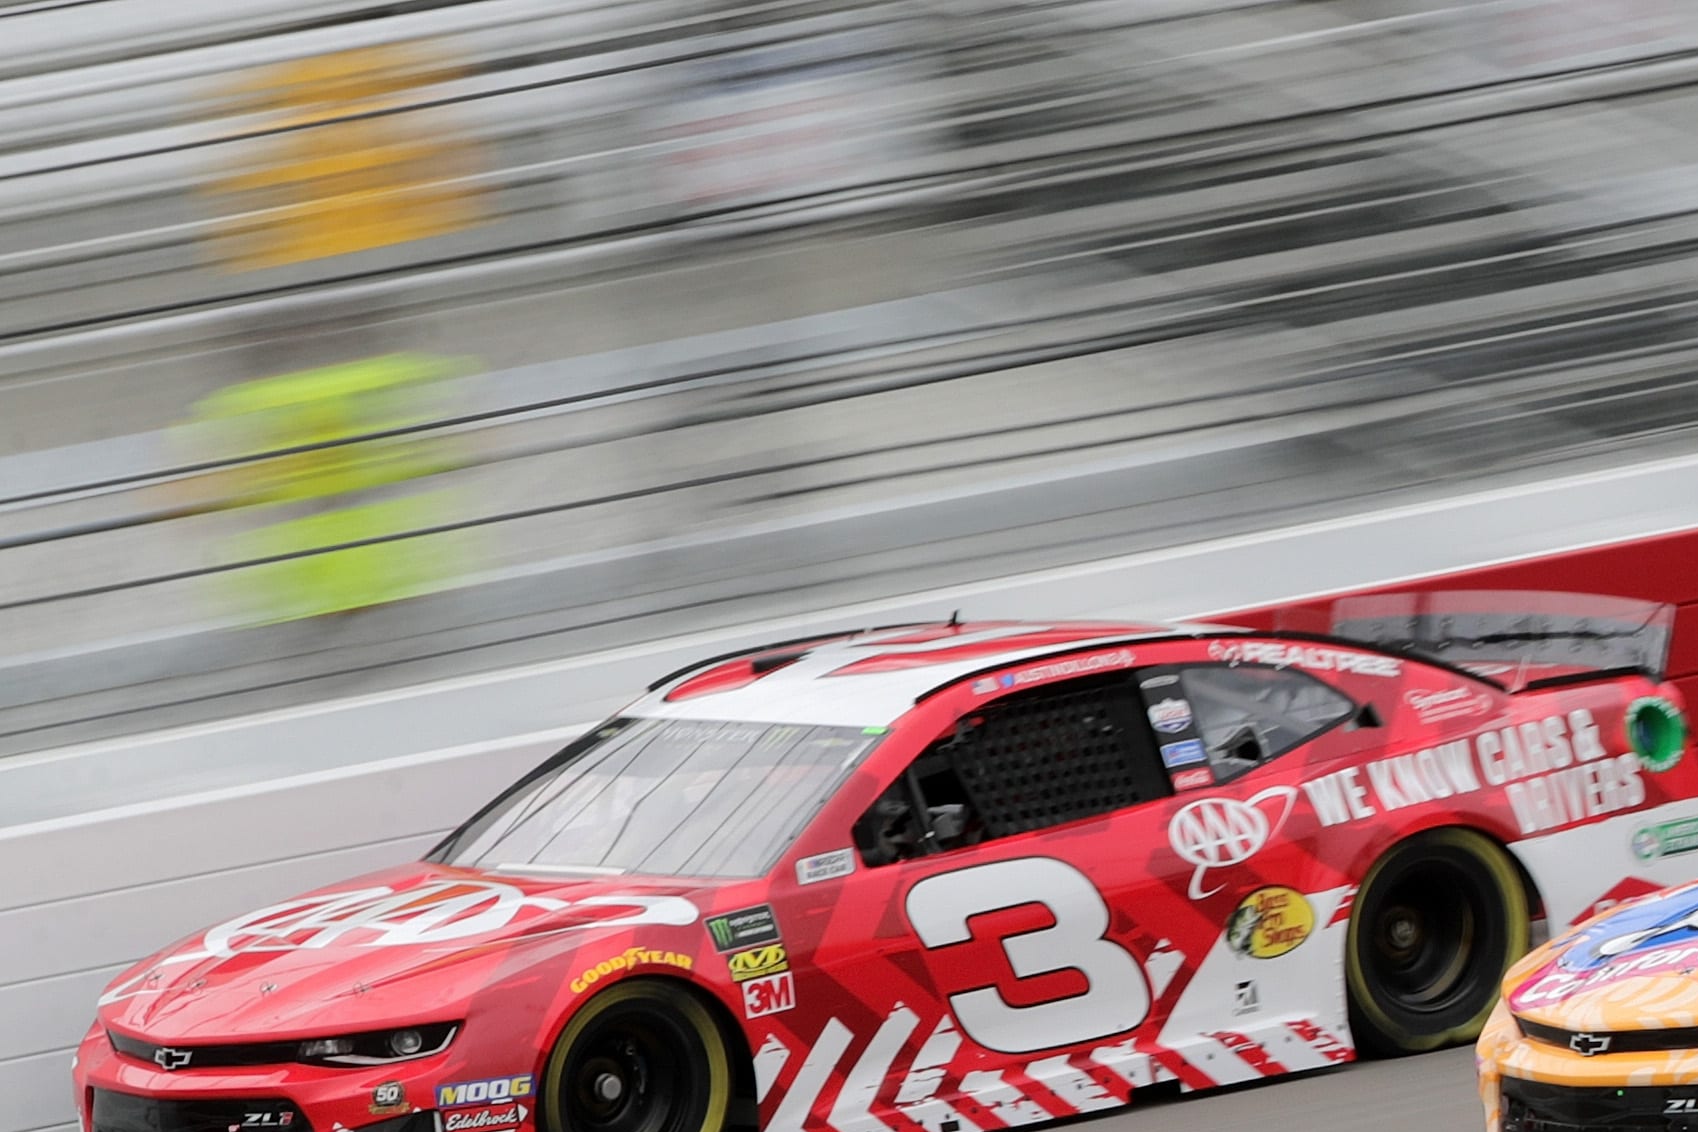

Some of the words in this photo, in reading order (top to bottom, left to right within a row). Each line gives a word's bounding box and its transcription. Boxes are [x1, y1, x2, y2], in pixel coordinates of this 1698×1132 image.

[1303, 766, 1376, 827] WE
[1367, 738, 1481, 811] KNOW
[1477, 715, 1573, 786] CARS
[1568, 708, 1607, 762] &
[1504, 752, 1646, 835] DRIVERS
[1174, 798, 1263, 866] AAA
[569, 946, 694, 994] GOODYEAR
[906, 857, 1151, 1053] 3
[748, 976, 793, 1014] 3M
[376, 1087, 399, 1102] 50
[440, 1076, 532, 1106] MOOG
[241, 1111, 294, 1127] ZL1
[446, 1109, 518, 1132] Edelbrock
